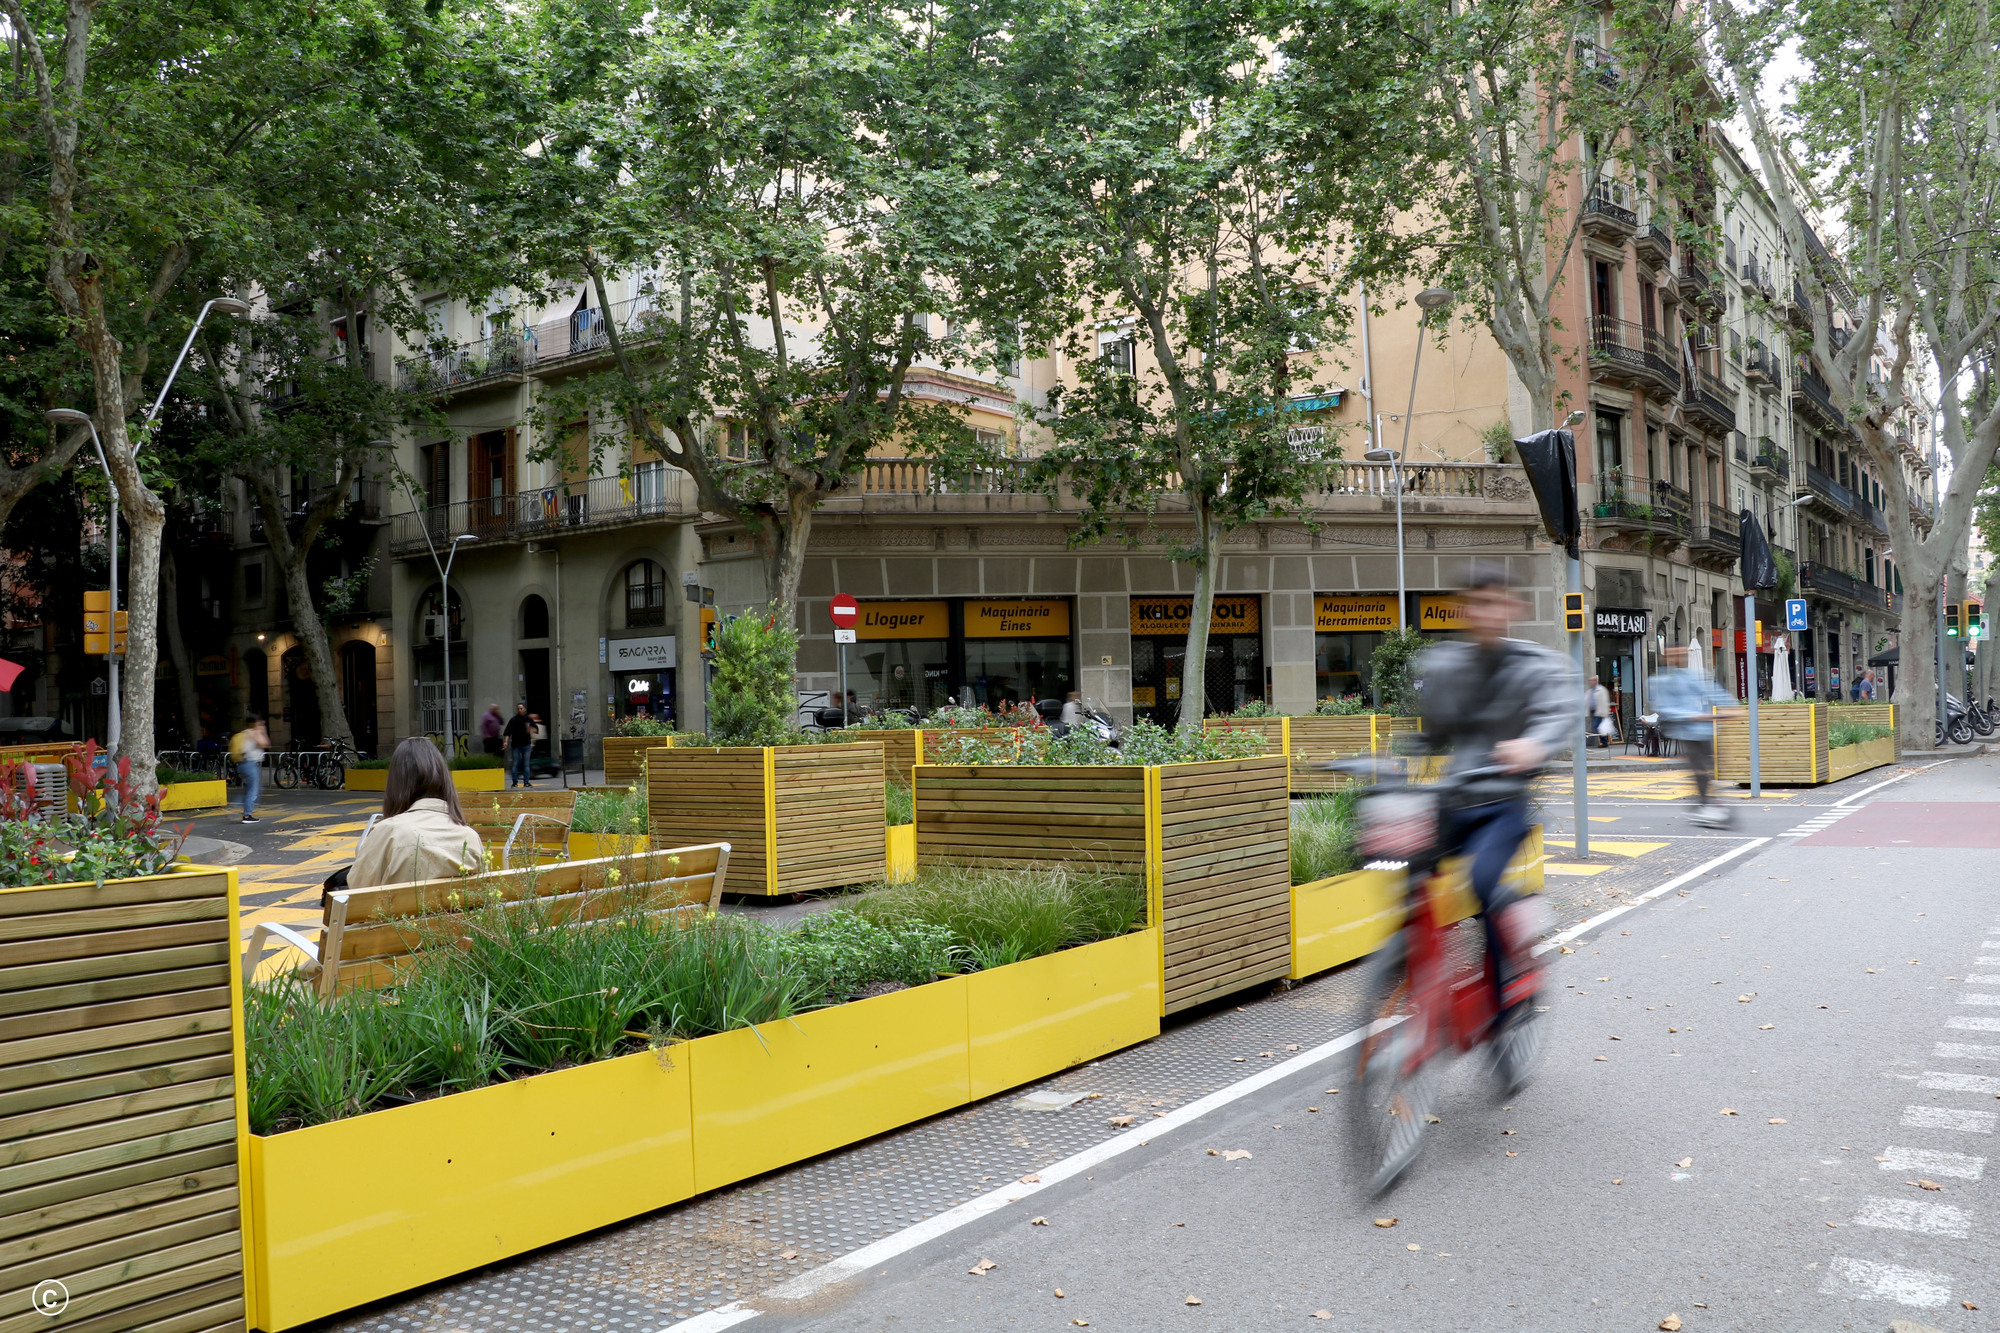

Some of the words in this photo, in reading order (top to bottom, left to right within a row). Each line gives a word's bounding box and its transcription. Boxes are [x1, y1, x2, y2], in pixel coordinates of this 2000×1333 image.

[980, 606, 1050, 620] Maquinària
[1322, 601, 1386, 615] Maquinaria
[1424, 605, 1470, 622] Alquil
[1793, 604, 1801, 616] P
[865, 612, 925, 629] Lloguer
[999, 620, 1032, 631] Eines
[1317, 615, 1392, 626] Herramientas
[1596, 613, 1618, 626] BAR
[1620, 615, 1646, 633] EASO
